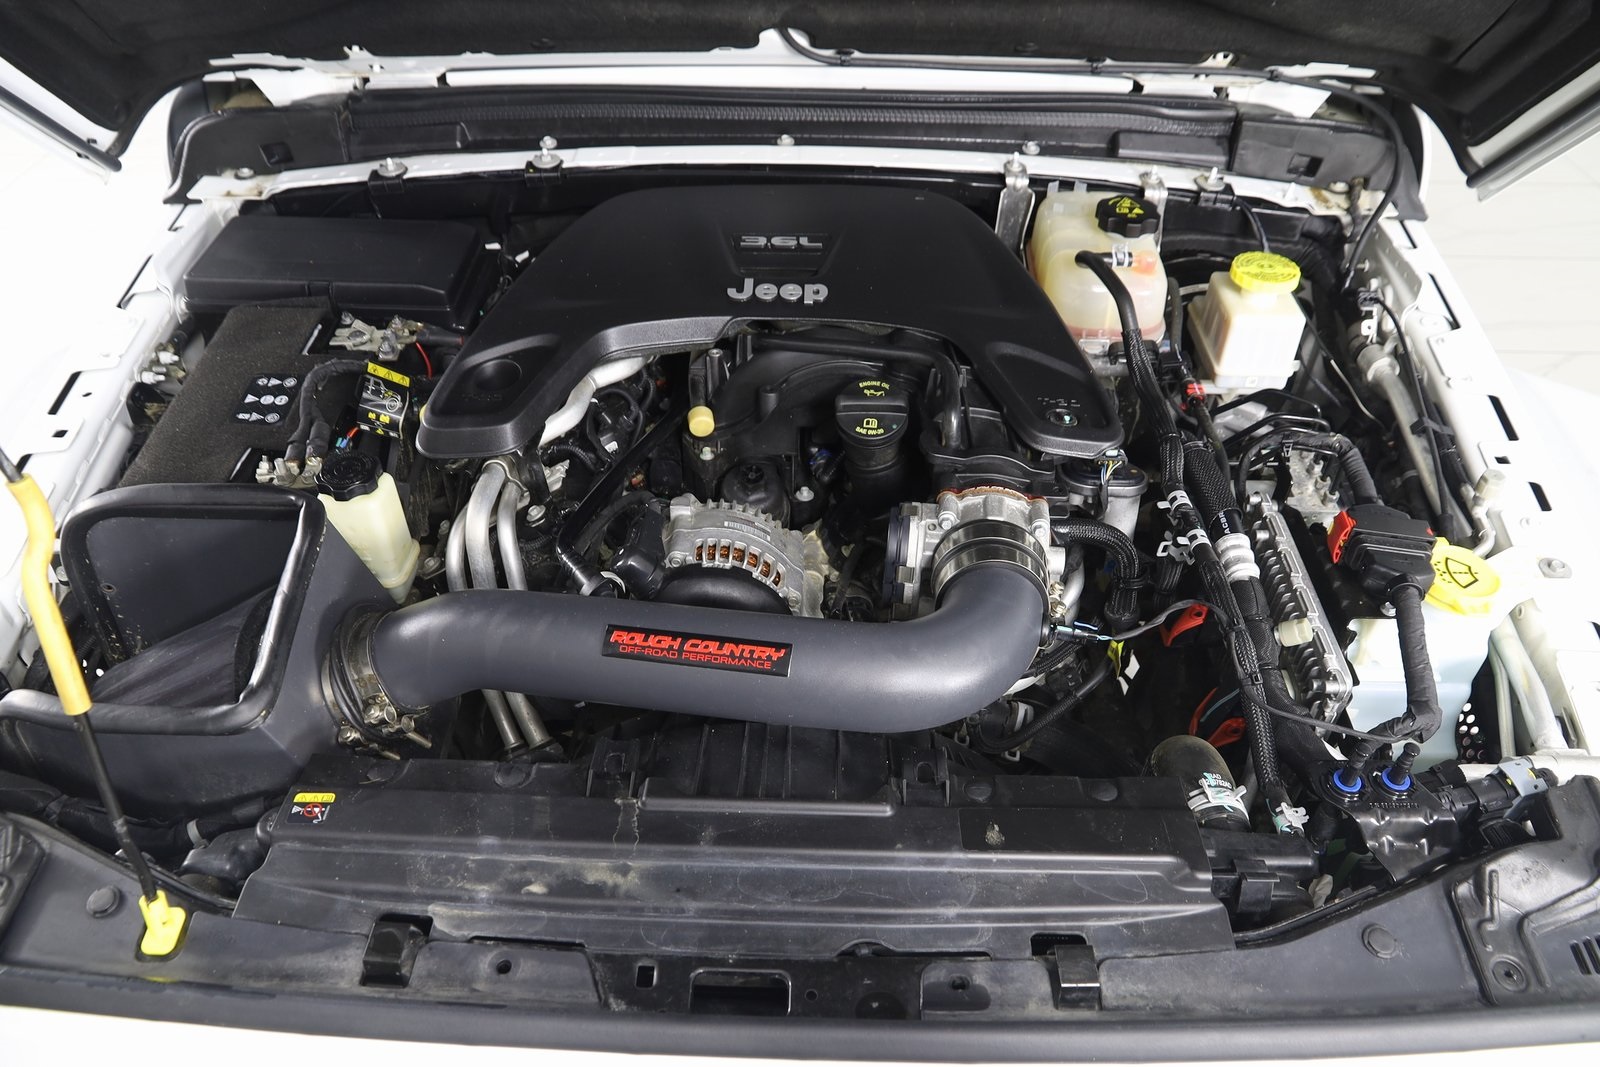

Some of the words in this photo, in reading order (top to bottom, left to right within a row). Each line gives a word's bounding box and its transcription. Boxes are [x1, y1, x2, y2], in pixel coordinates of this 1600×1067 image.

[726, 277, 829, 306] Jeep
[881, 382, 890, 390] OIL
[856, 426, 867, 434] SAE
[609, 630, 682, 650] ROUGH
[683, 638, 786, 661] COUNTRY
[619, 646, 678, 658] OFF-ROAD
[682, 652, 772, 669] PERFORMANCE
